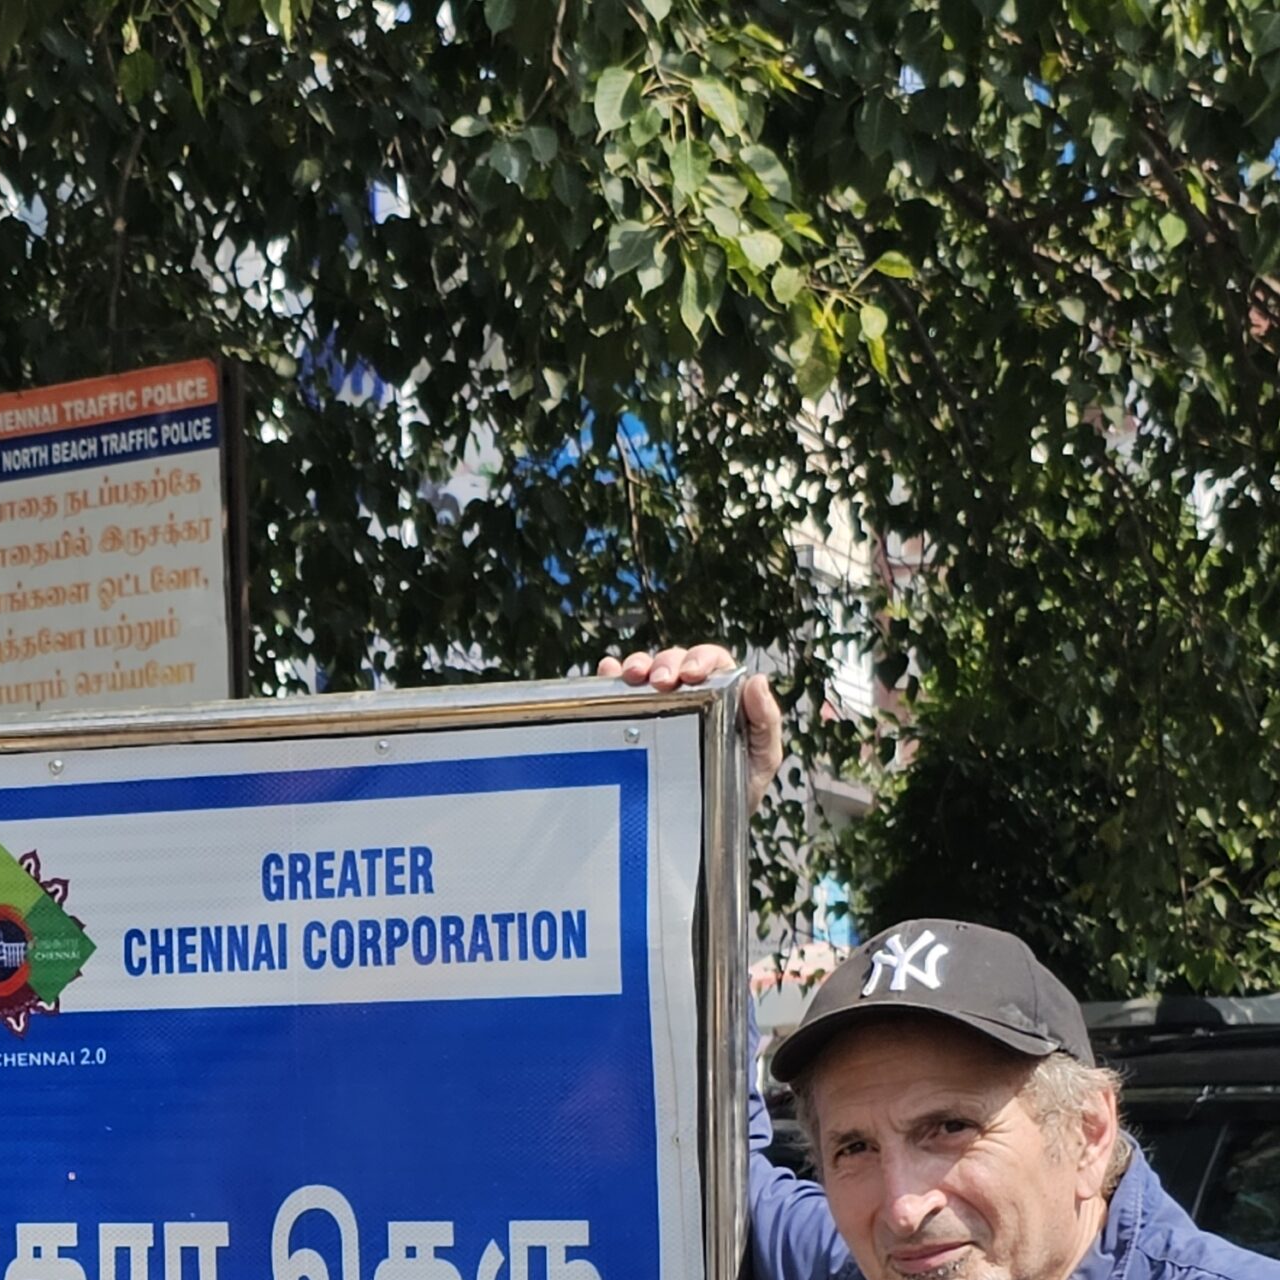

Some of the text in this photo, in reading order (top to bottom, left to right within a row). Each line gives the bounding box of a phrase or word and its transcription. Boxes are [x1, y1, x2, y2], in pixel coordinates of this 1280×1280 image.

[63, 389, 137, 421] TRAFFIC
[142, 377, 209, 407] POLICE
[2, 446, 49, 473] NORTH
[52, 438, 98, 464] BEACH
[101, 426, 158, 456] TRAFFIC
[161, 417, 212, 444] POLICE
[63, 468, 201, 518] நடப்பதற்கே
[98, 513, 213, 555] இருசக்கர
[94, 607, 180, 651] மற்றும்
[262, 846, 434, 901] GREATER
[124, 910, 587, 976] CHENNAI CORPORATION
[80, 1048, 107, 1065] 2.0
